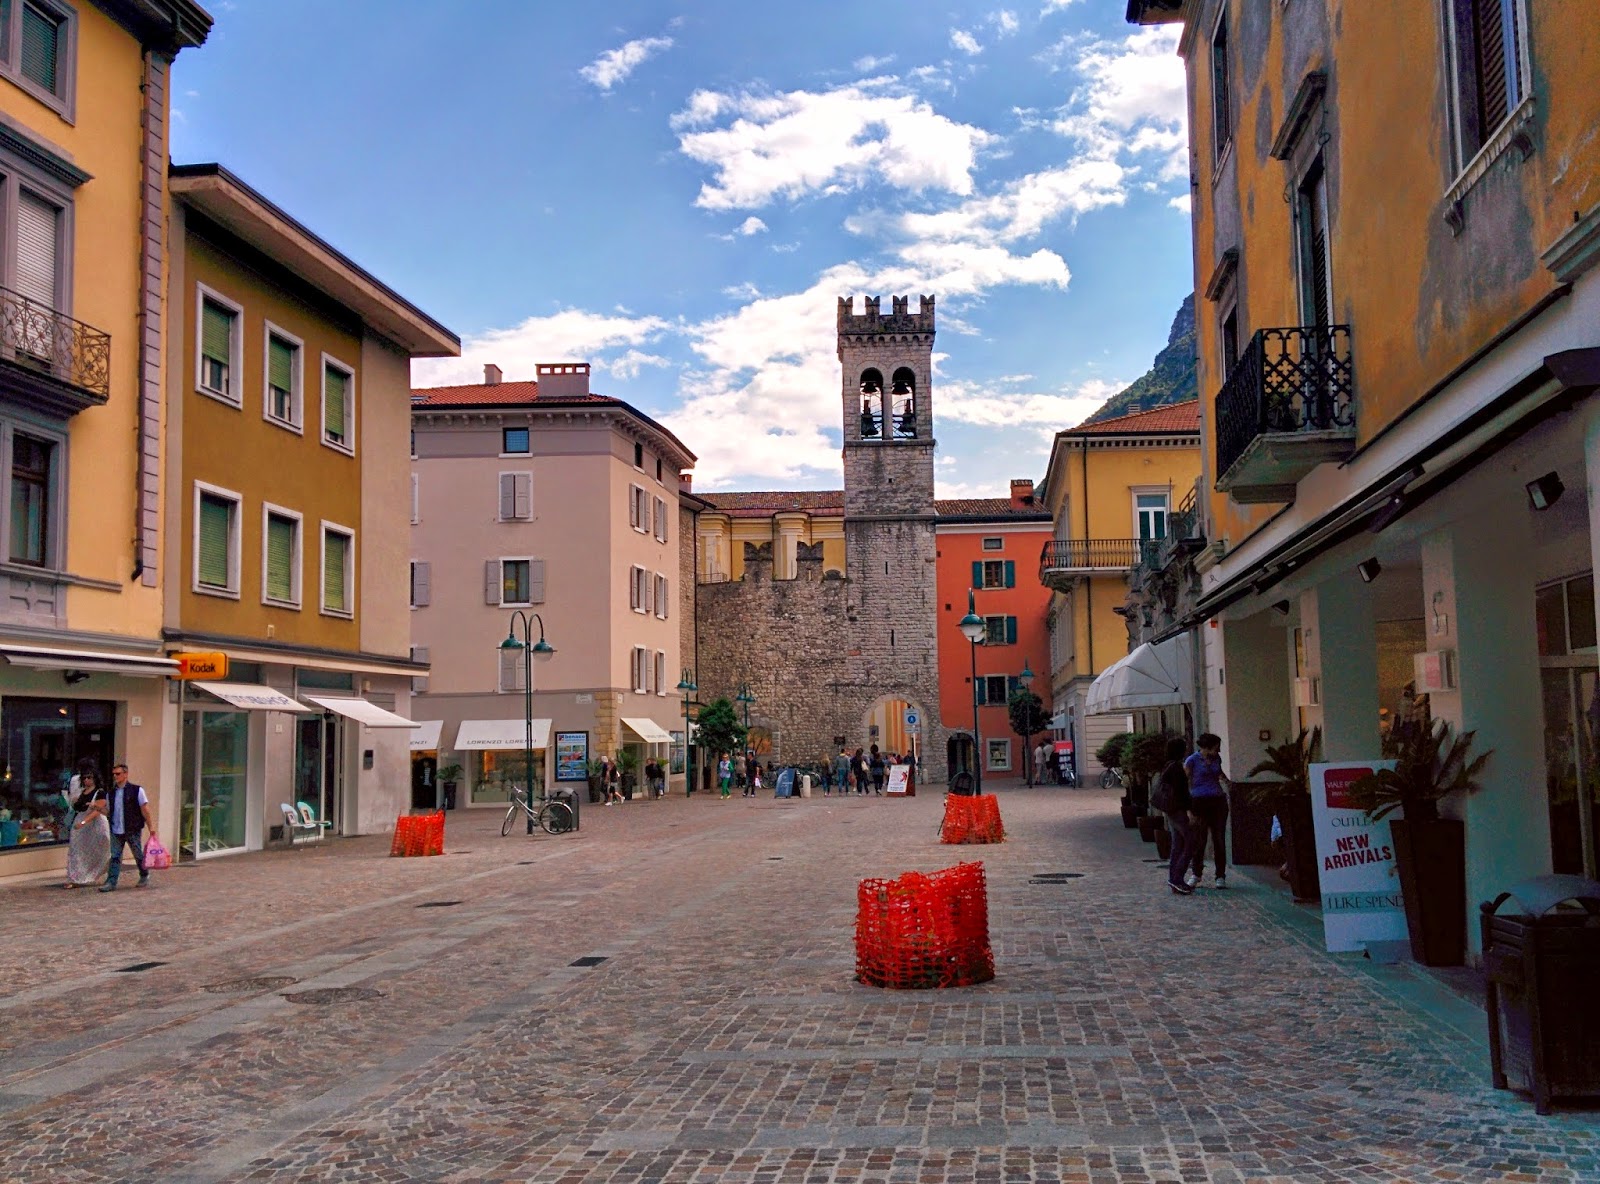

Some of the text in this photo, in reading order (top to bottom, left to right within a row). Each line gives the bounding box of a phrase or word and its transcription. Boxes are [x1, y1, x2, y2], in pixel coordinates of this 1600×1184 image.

[189, 662, 216, 673] Kodak
[1336, 834, 1369, 852] NEW
[1325, 846, 1392, 870] ARRIVALS
[1335, 897, 1361, 909] LIKE
